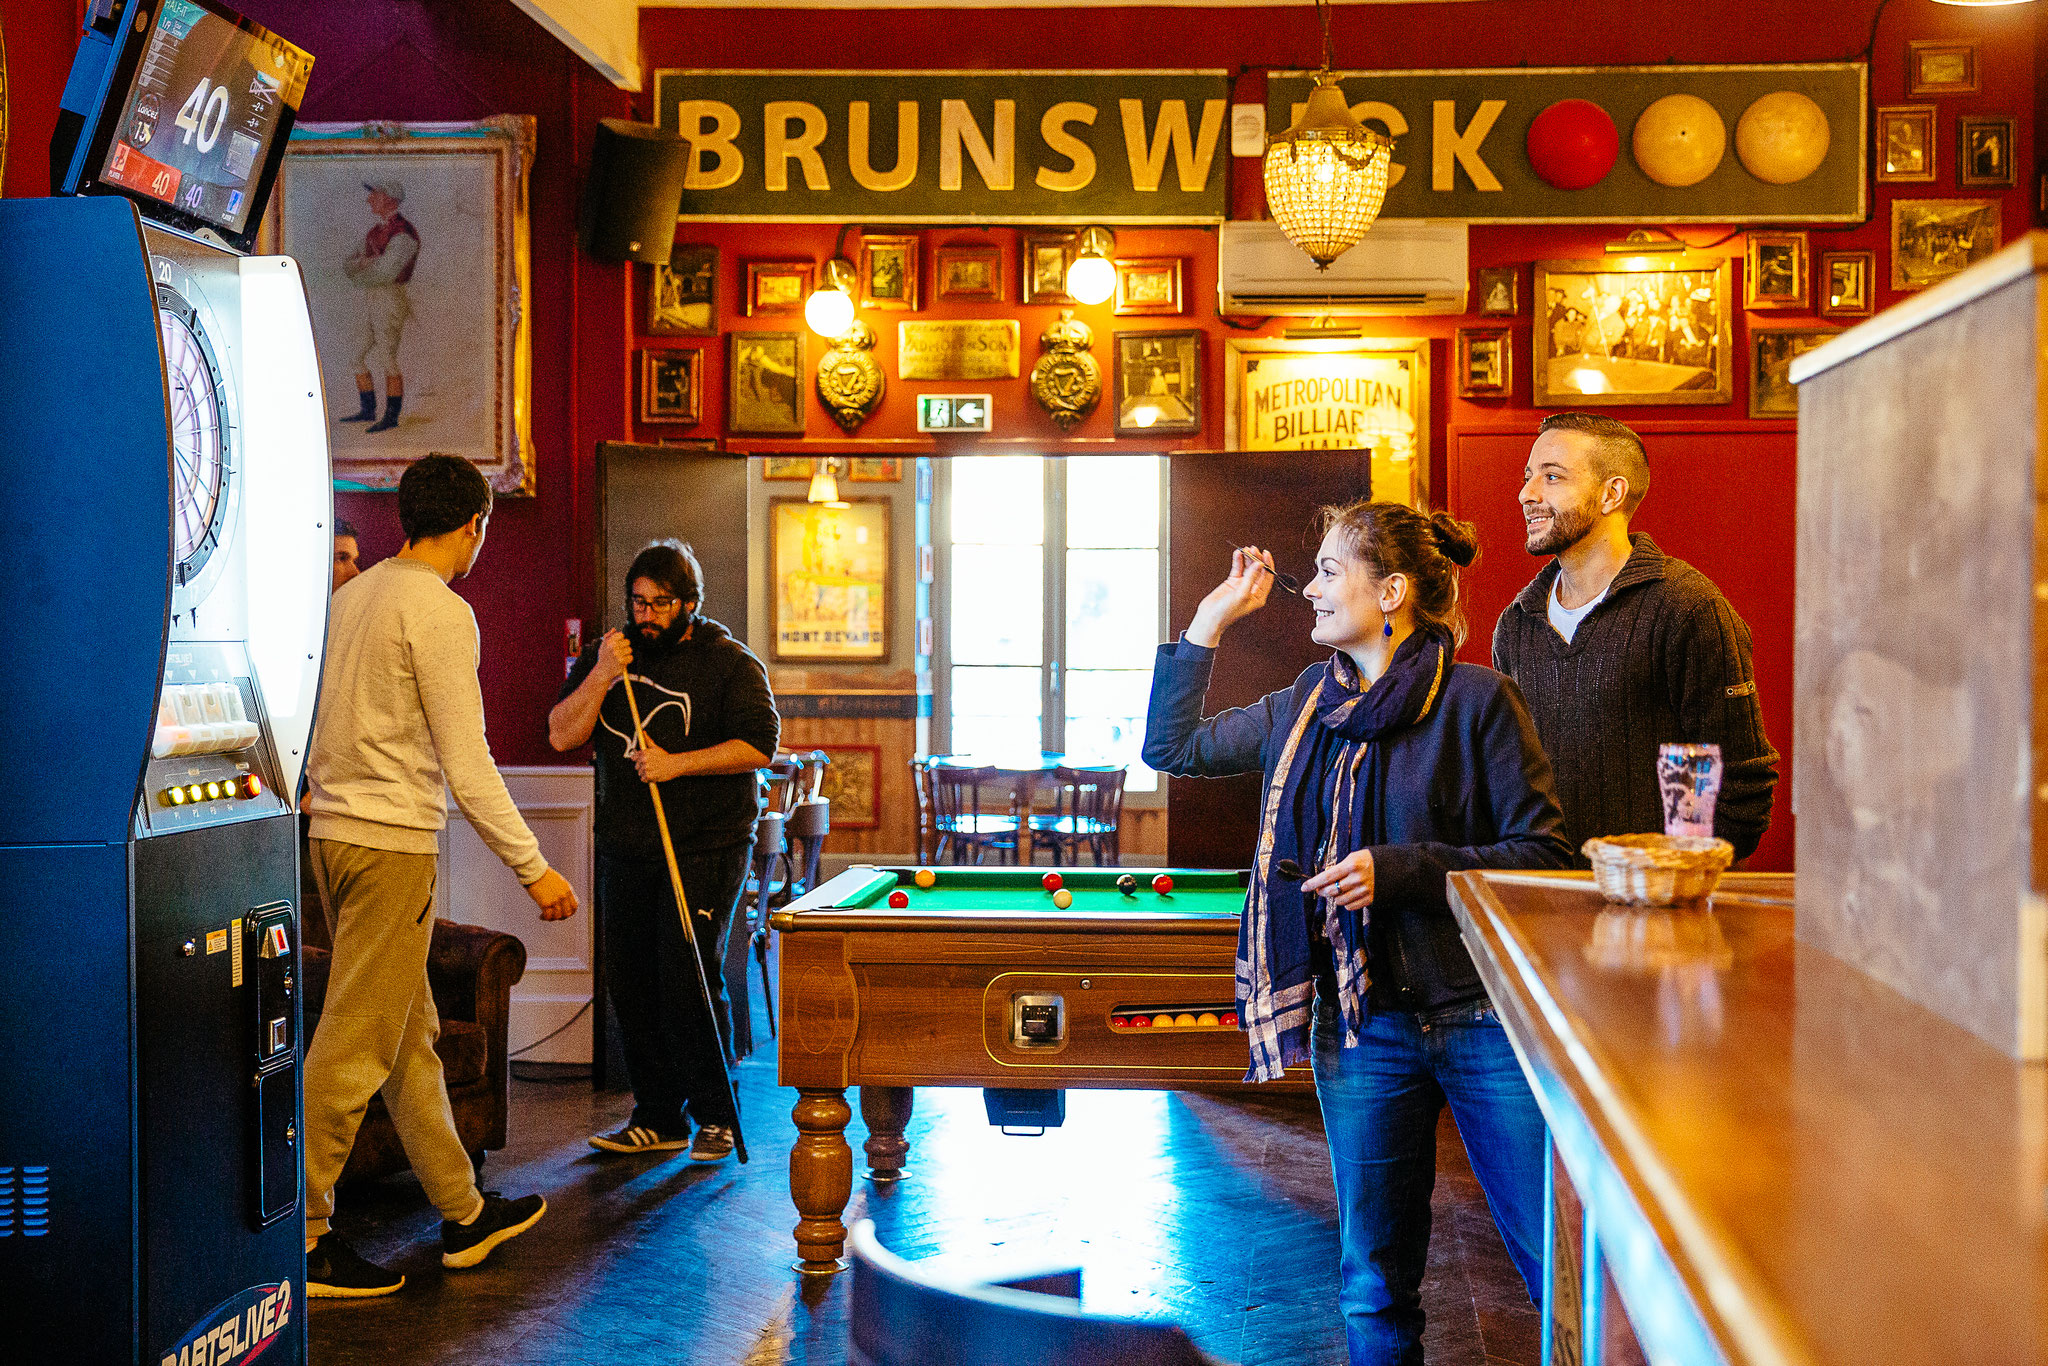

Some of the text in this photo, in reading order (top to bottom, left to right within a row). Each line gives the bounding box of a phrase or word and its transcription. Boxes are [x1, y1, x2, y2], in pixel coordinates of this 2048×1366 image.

[137, 101, 159, 120] Lancez
[174, 76, 229, 154] 40
[134, 121, 148, 142] 15
[679, 98, 1507, 191] BRUNSWCK
[151, 170, 170, 196] 40
[184, 183, 202, 208] 40
[158, 261, 171, 283] 20
[184, 277, 190, 297] 1
[1254, 377, 1401, 432] METROPOLITAN
